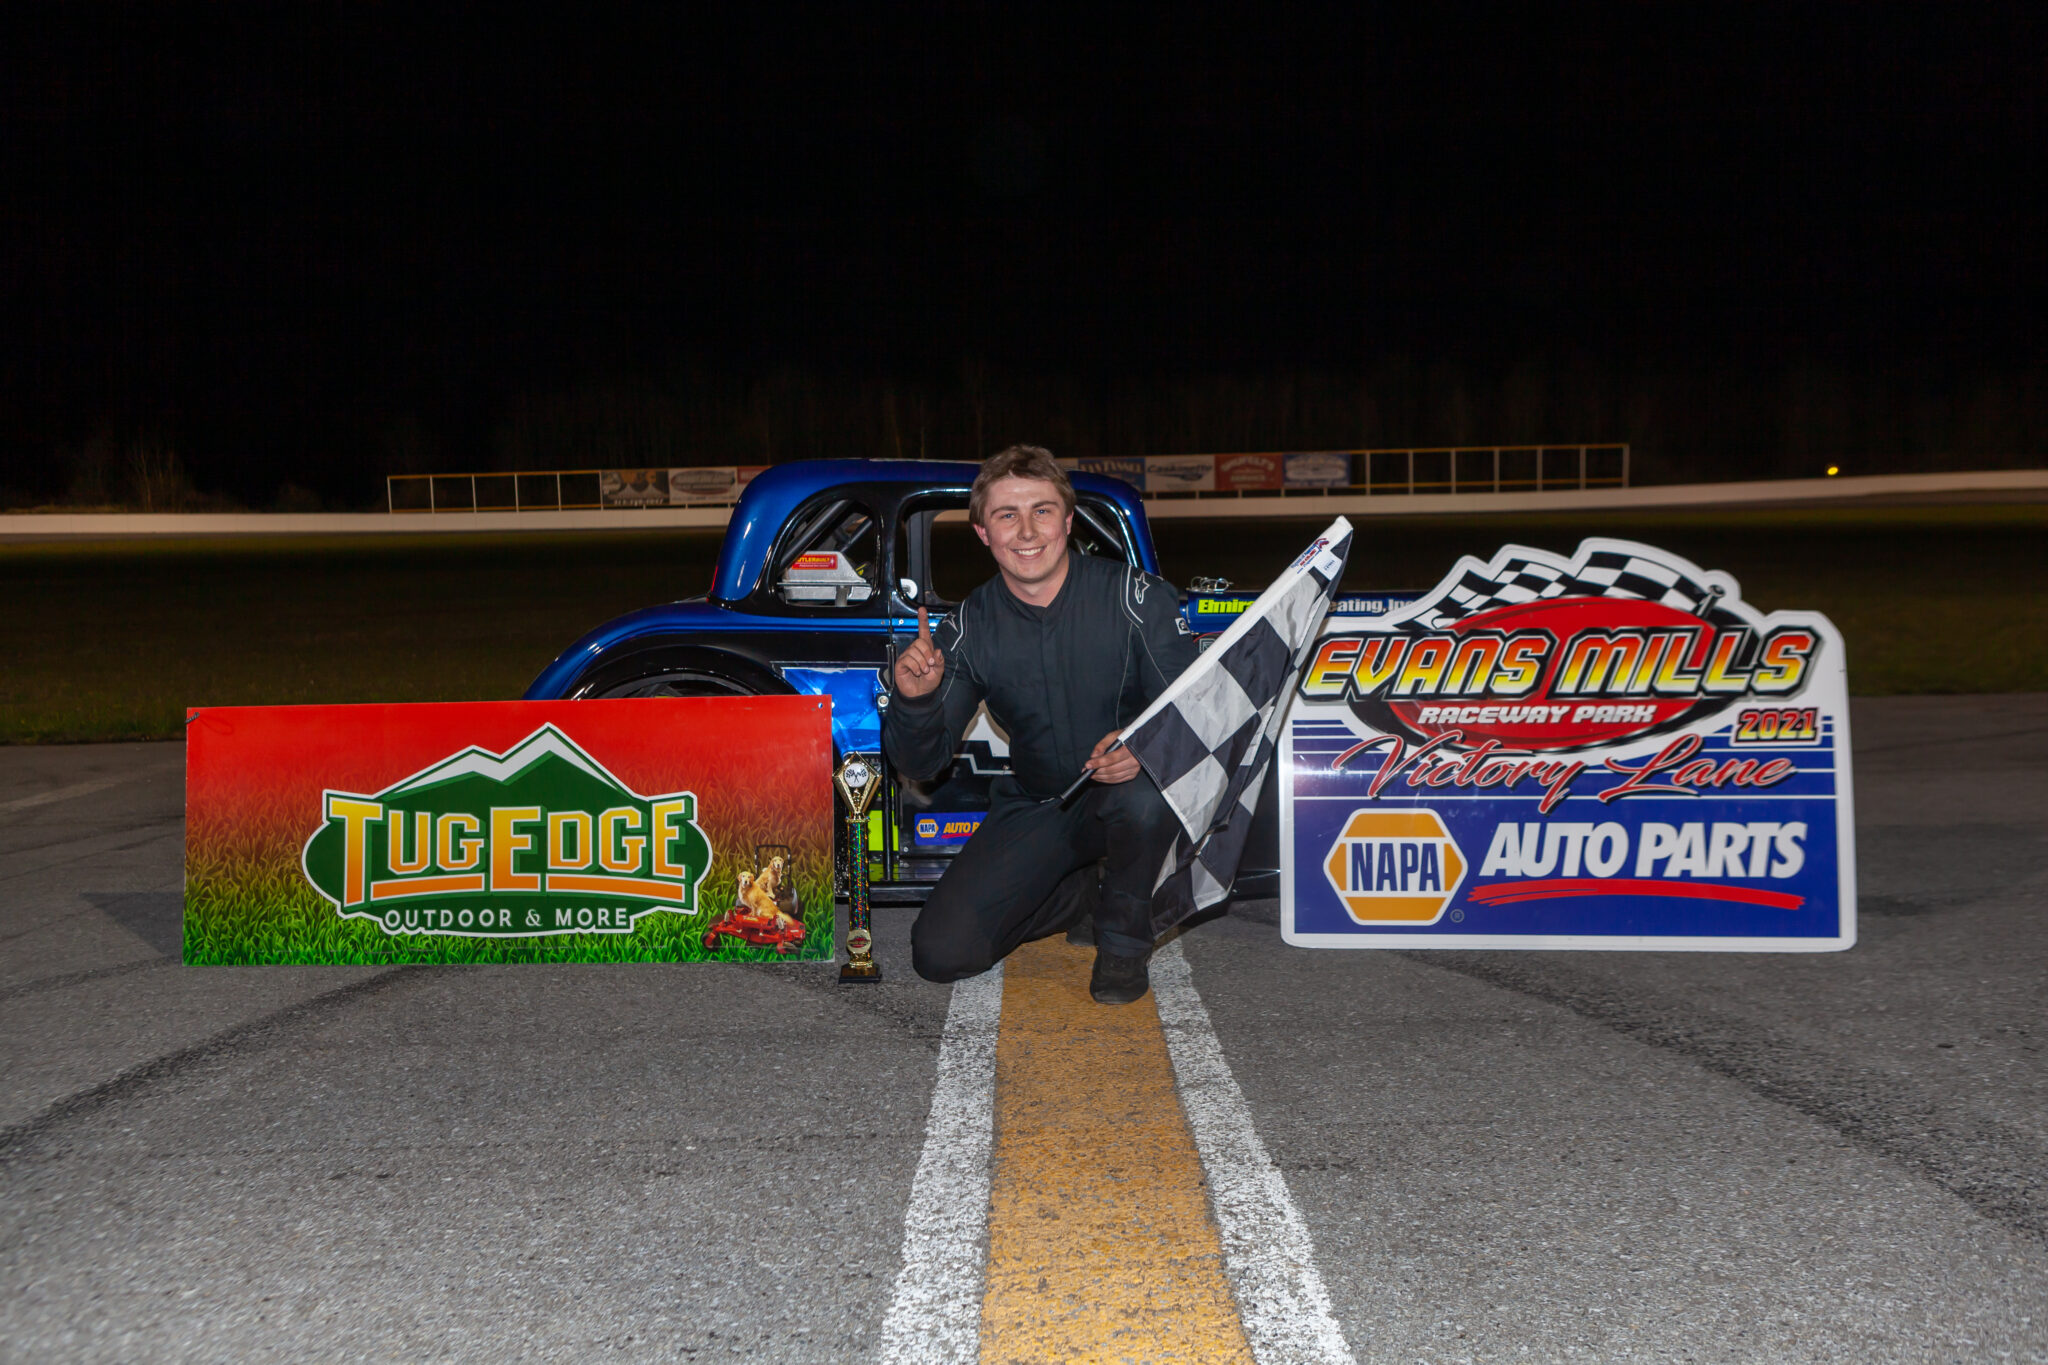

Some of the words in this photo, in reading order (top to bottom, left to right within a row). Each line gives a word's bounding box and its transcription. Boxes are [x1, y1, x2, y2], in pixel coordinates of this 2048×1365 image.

[1328, 598, 1387, 614] eating,
[1301, 636, 1552, 697] EVANS
[1554, 632, 1815, 696] MILLS
[1417, 705, 1571, 725] RACEWAY
[1572, 704, 1657, 724] PARK
[1735, 708, 1819, 743] 2021
[1331, 730, 1585, 814] Victory
[1598, 733, 1797, 803] Lane
[919, 823, 936, 833] NAPA
[943, 822, 971, 833] AUTO
[1351, 842, 1441, 893] NAPA
[1479, 821, 1631, 878] AUTO
[1634, 821, 1808, 879] PARTS
[384, 908, 512, 929] OUTDOOR
[525, 907, 544, 928] &
[554, 906, 630, 928] MORE
